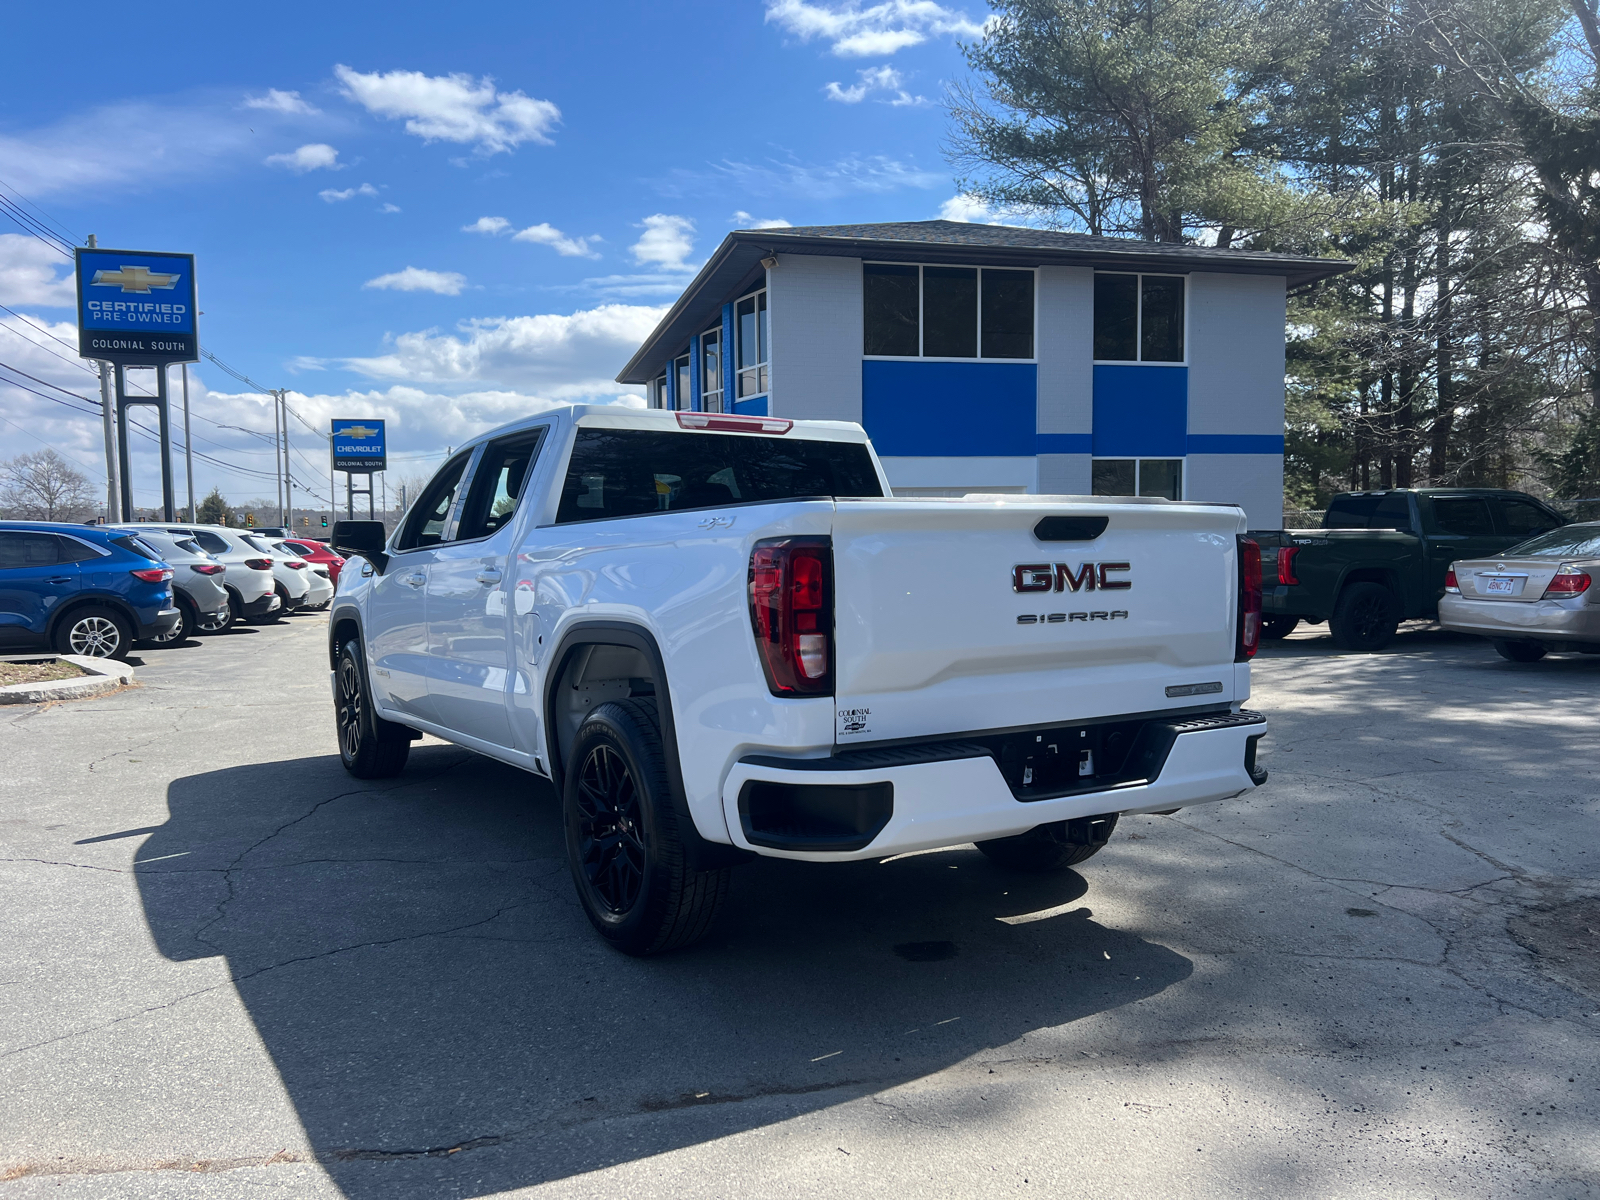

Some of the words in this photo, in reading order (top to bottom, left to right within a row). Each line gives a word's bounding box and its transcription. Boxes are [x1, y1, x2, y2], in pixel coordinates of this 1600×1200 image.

[88, 301, 186, 314] CERTIFIED
[93, 311, 182, 324] PRE-OWNED
[92, 339, 145, 350] COLONIAL
[151, 341, 185, 351] SOUTH
[1012, 562, 1132, 593] GMC
[1016, 610, 1129, 625] SIERRA
[838, 708, 872, 717] COLONIAL
[843, 715, 867, 724] SOUTH
